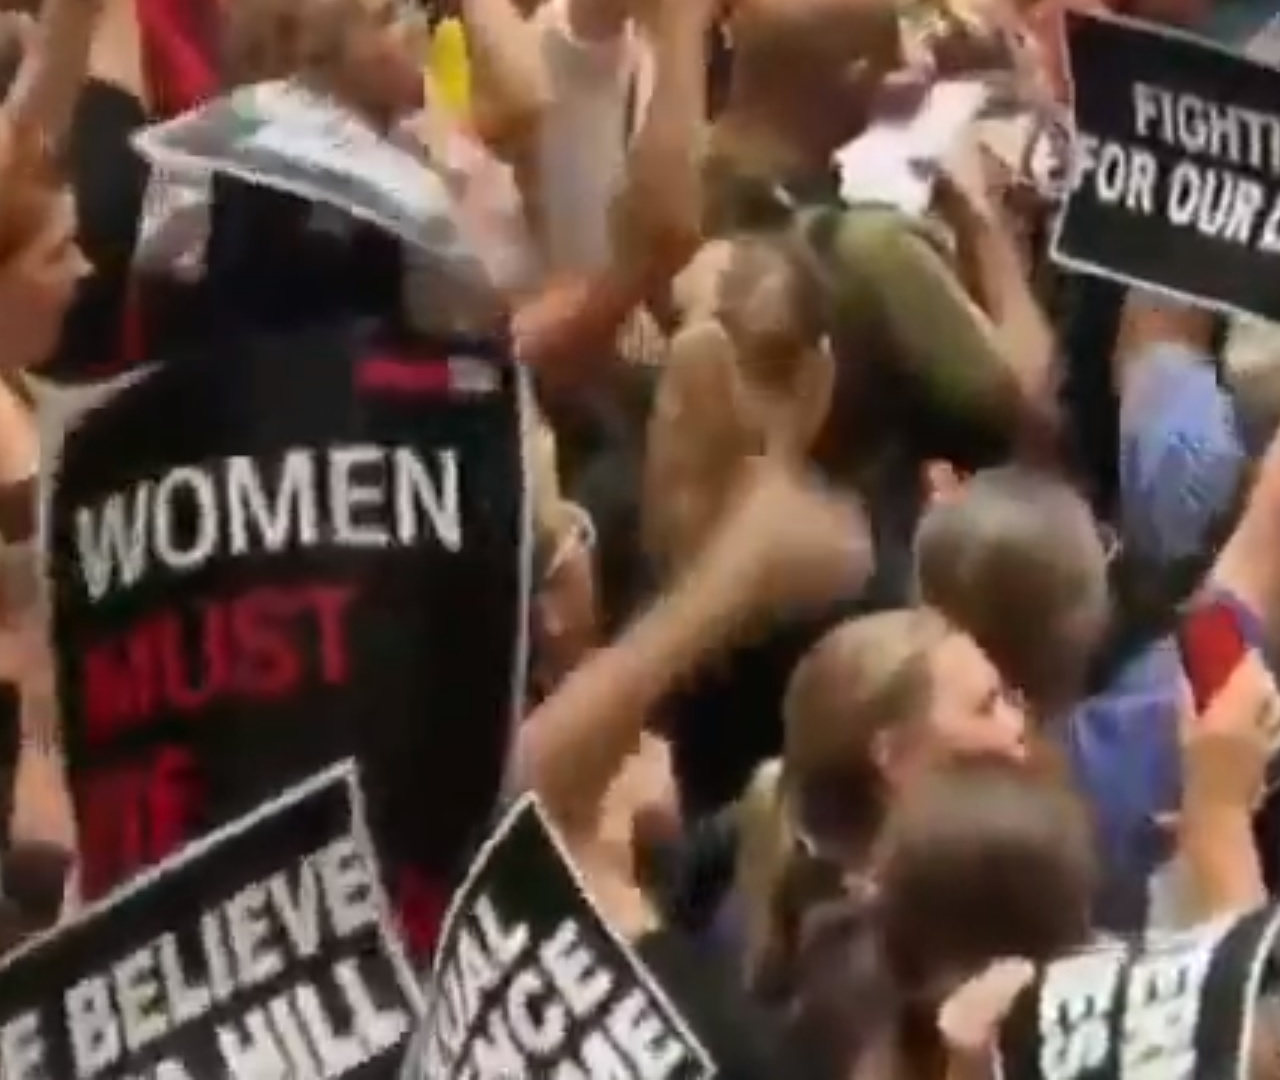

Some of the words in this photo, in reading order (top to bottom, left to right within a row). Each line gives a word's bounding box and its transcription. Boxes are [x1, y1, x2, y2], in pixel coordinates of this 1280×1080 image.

[1074, 133, 1158, 217] FOR
[1167, 161, 1258, 245] OUR
[75, 444, 463, 604] WOMEN
[81, 584, 360, 748] MUST
[64, 834, 378, 1080] BELIEVE
[214, 957, 412, 1080] HILL
